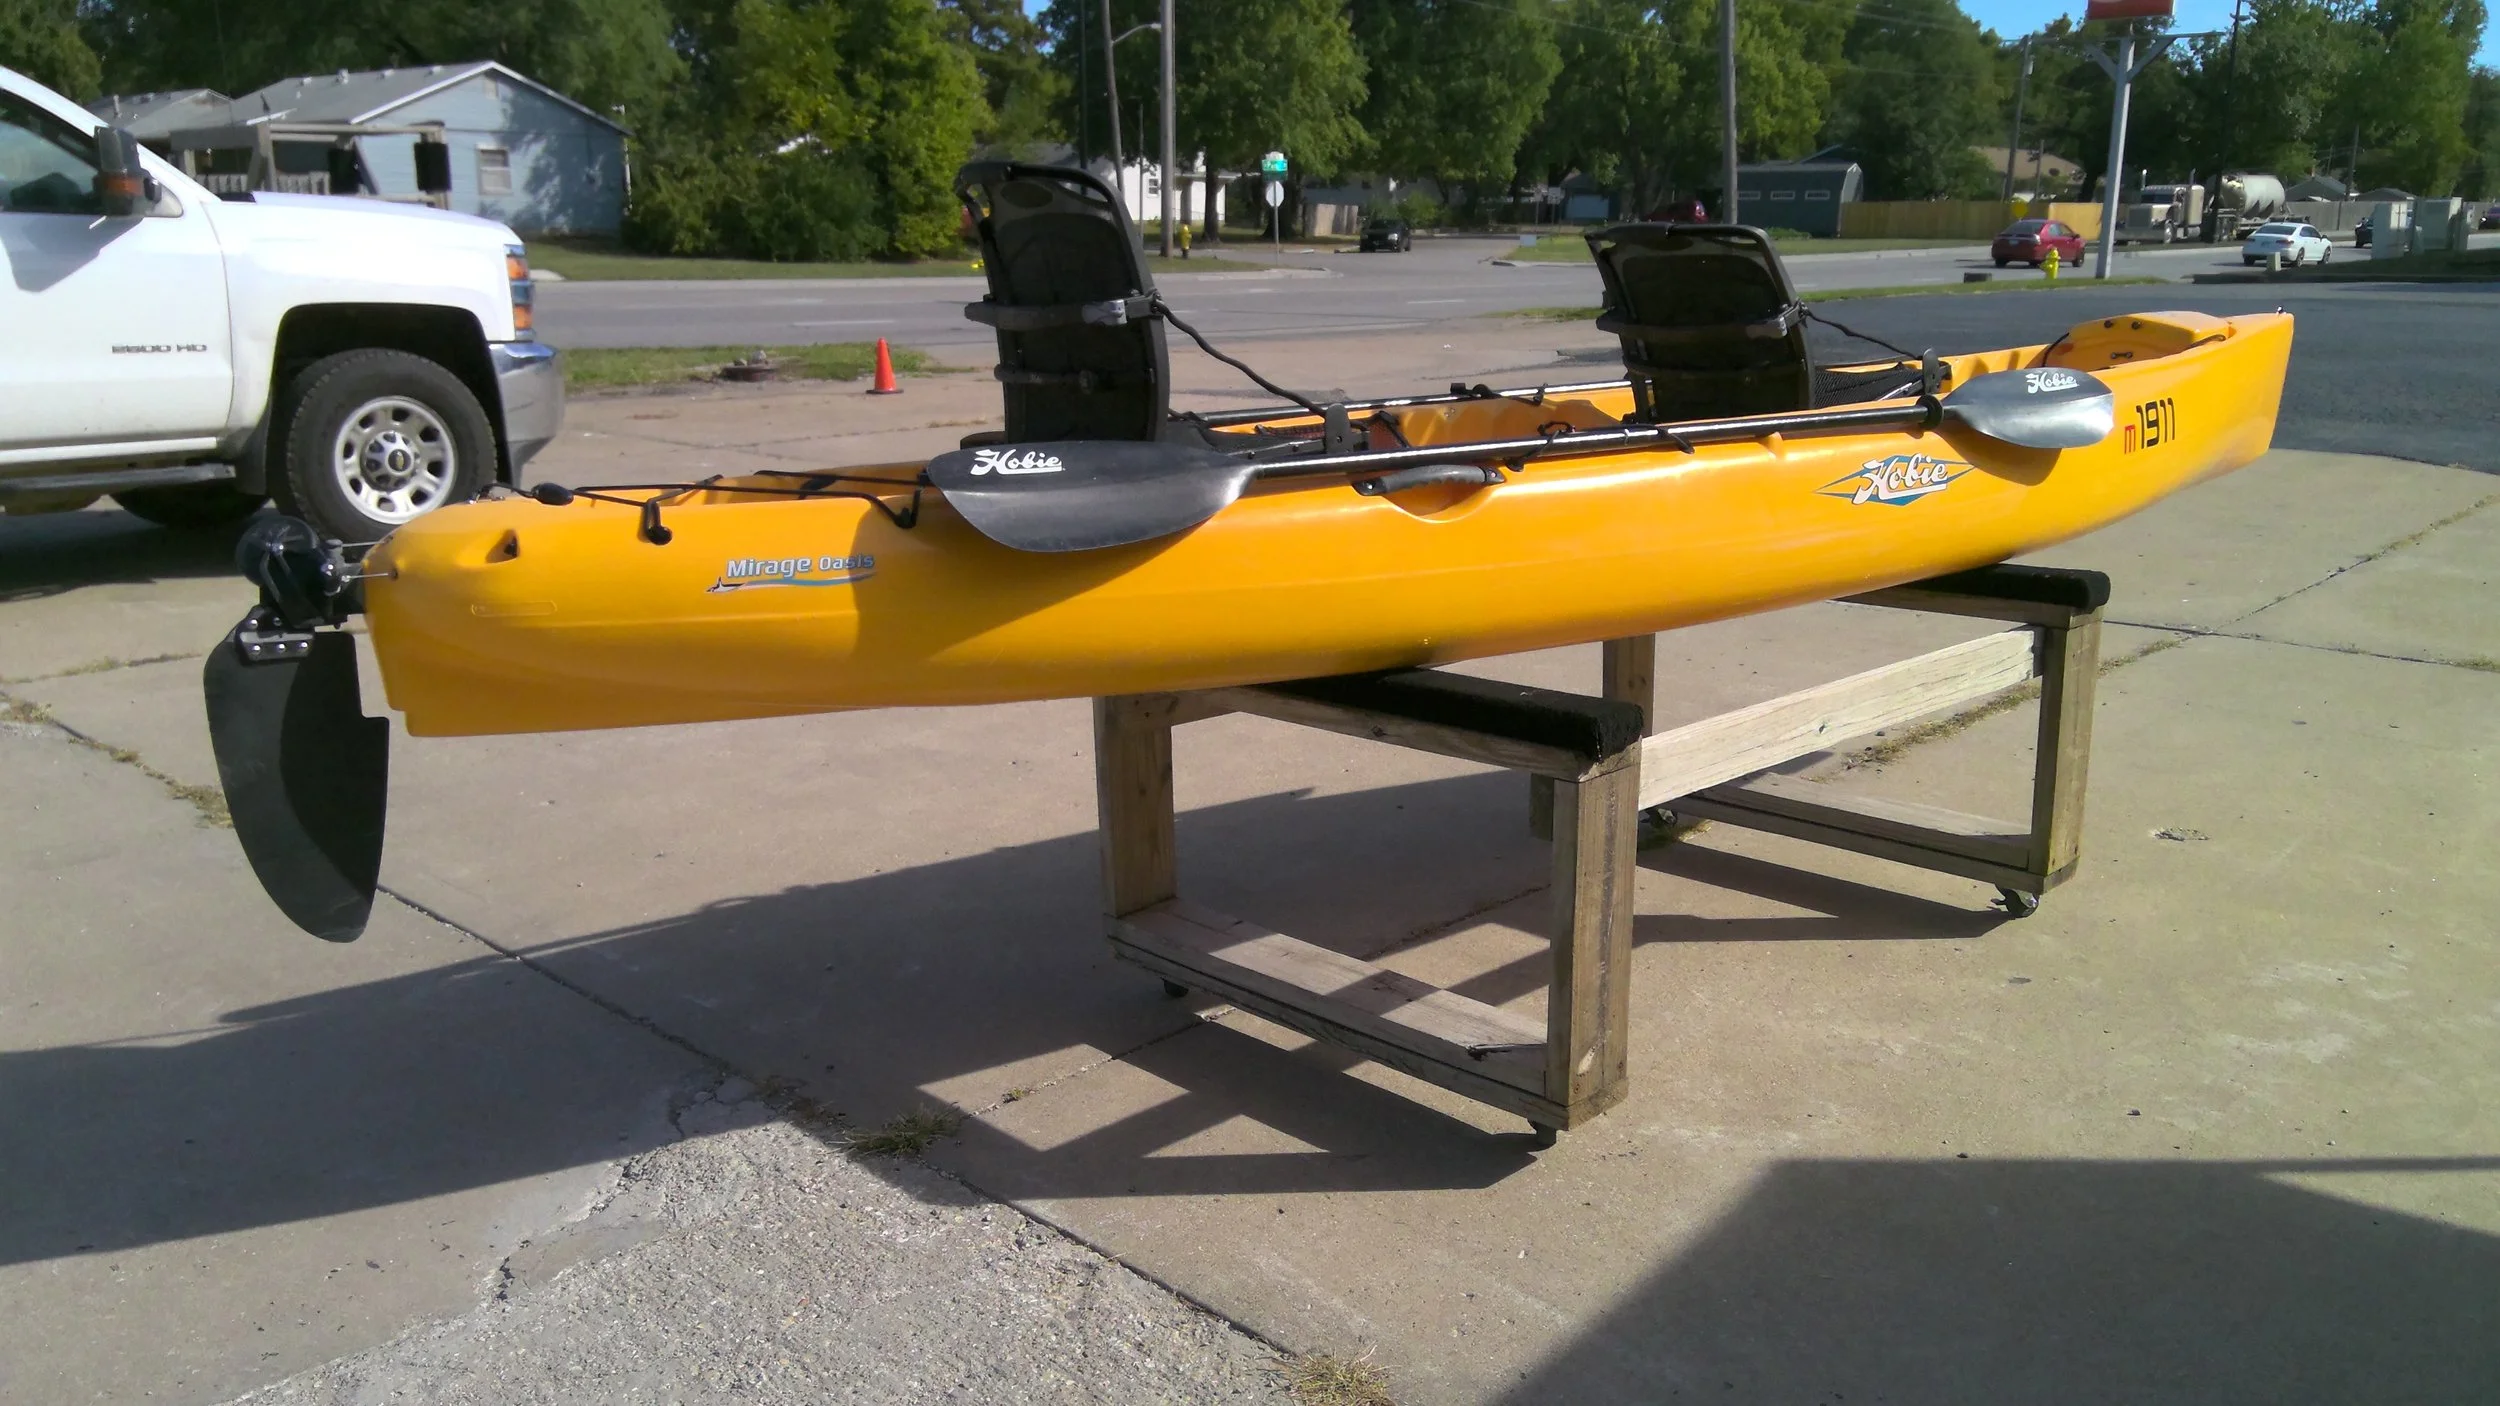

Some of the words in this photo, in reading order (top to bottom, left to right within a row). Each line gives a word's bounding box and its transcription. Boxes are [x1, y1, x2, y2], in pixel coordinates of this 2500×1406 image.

[176, 343, 207, 352] HD
[2025, 372, 2079, 394] Hobie
[970, 449, 1066, 476] Hobie
[1851, 453, 1948, 505] Hobie
[727, 556, 812, 579] Mirage
[818, 553, 875, 571] Oasis
